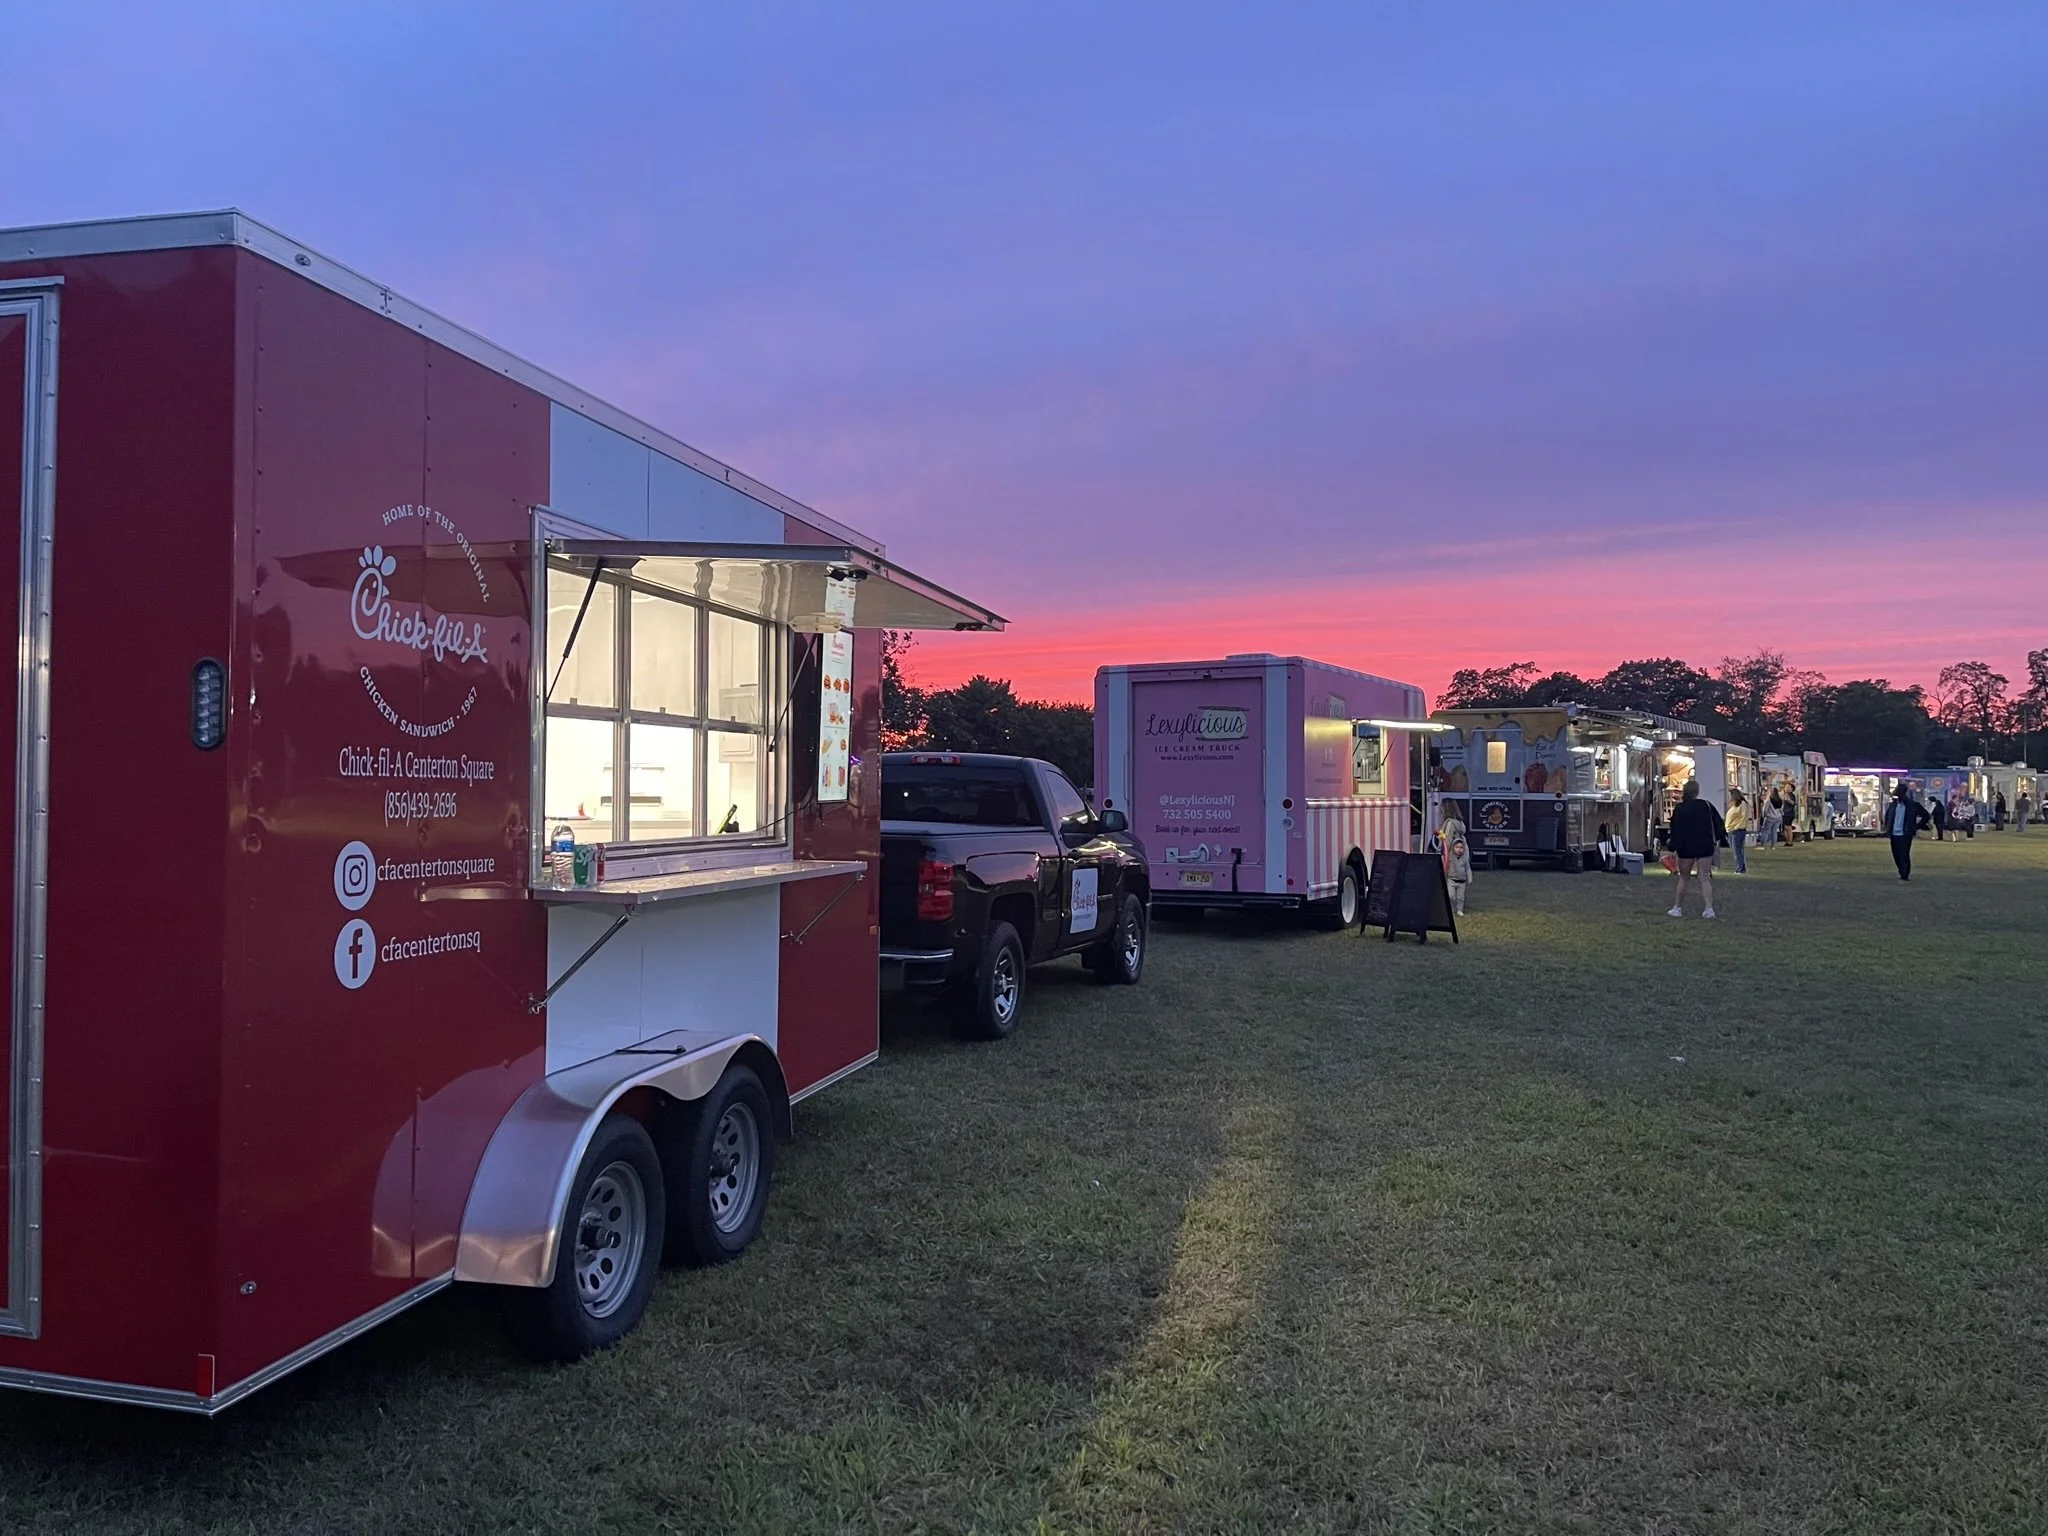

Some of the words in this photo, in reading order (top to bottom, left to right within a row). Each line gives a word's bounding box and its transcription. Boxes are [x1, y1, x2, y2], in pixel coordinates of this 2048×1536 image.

[382, 504, 413, 526] HOME
[417, 505, 432, 518] OF
[434, 511, 454, 534] THE
[456, 532, 490, 602] ORIGINAL
[351, 566, 488, 664] Chick-fil-A
[360, 666, 399, 725] CHICKEN
[399, 717, 455, 737] SANDWICH
[460, 686, 478, 716] 1967
[1145, 713, 1245, 742] Lexylicious
[1208, 744, 1240, 752] TRUCK
[339, 746, 403, 777] Chick-fil-A
[405, 751, 458, 779] Centerton
[460, 754, 494, 787] Square
[384, 790, 457, 828] (856)439-2696
[1159, 794, 1235, 807] @LexyliciousNJ
[1162, 809, 1182, 819] 732
[1184, 809, 1203, 819] 505
[1205, 809, 1231, 819] 5400
[376, 856, 495, 882] cfacentertonsquare
[381, 930, 481, 962] cfacentertonsq
